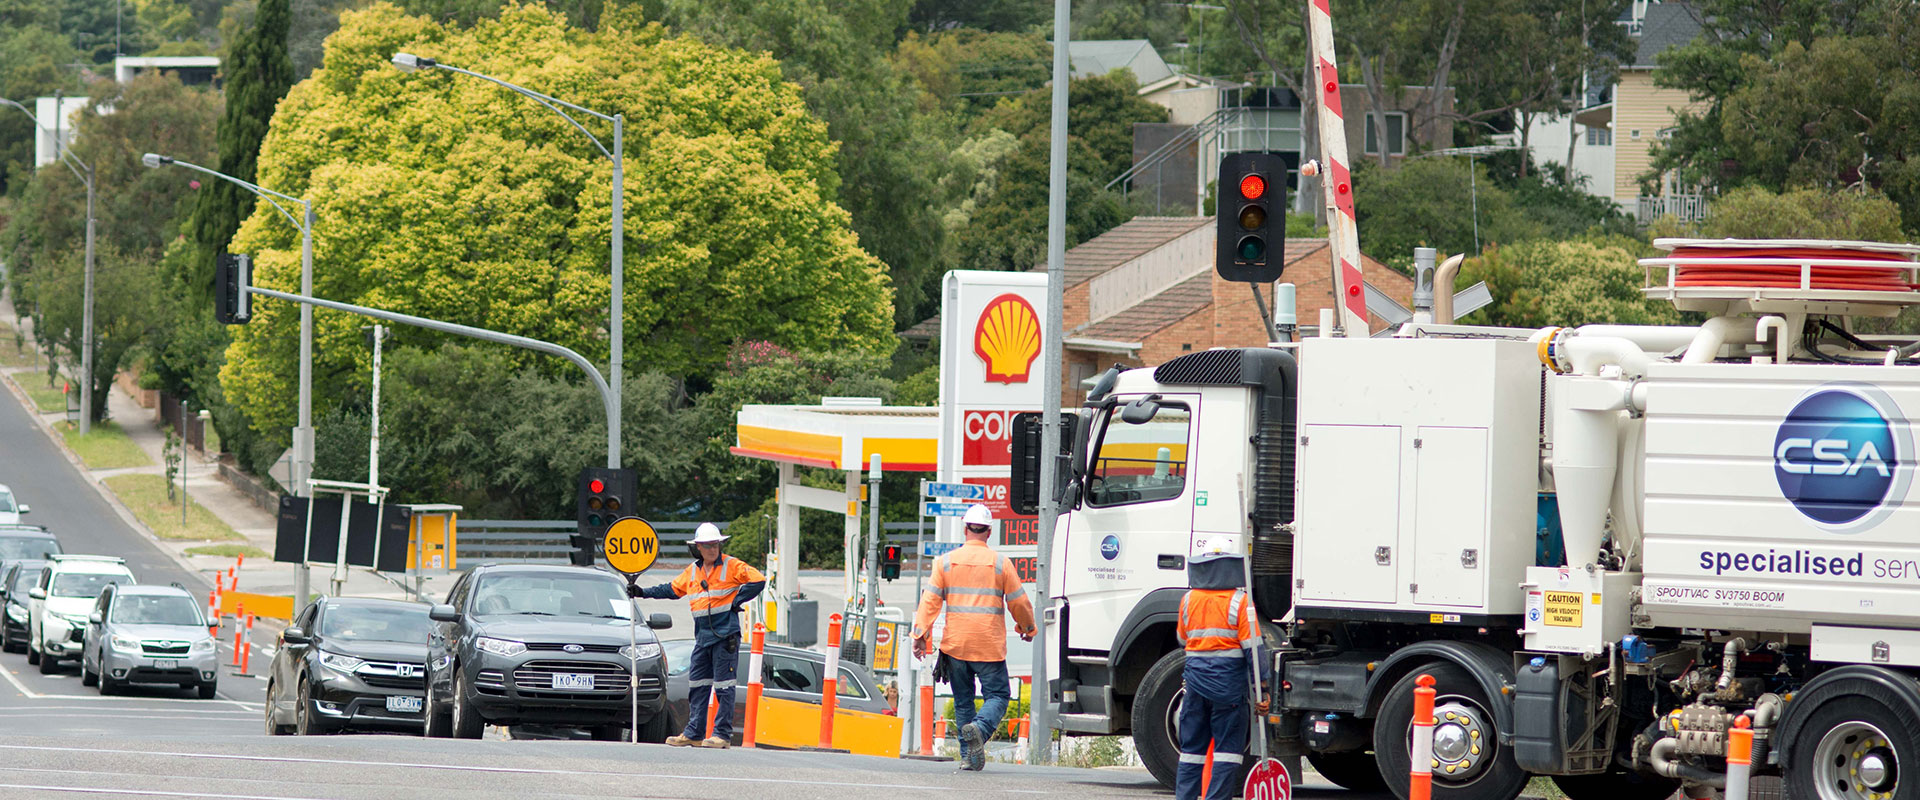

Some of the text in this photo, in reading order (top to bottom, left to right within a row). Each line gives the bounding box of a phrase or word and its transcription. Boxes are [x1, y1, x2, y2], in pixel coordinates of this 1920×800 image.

[1776, 437, 1892, 477] CSA
[986, 485, 1007, 500] ve
[608, 537, 655, 555] SLOW
[1101, 544, 1119, 552] CSA
[1699, 549, 1863, 577] specialised
[1547, 594, 1580, 604] CAUTION
[1656, 587, 1785, 602] SPOUTVAC SV3750 BOOM
